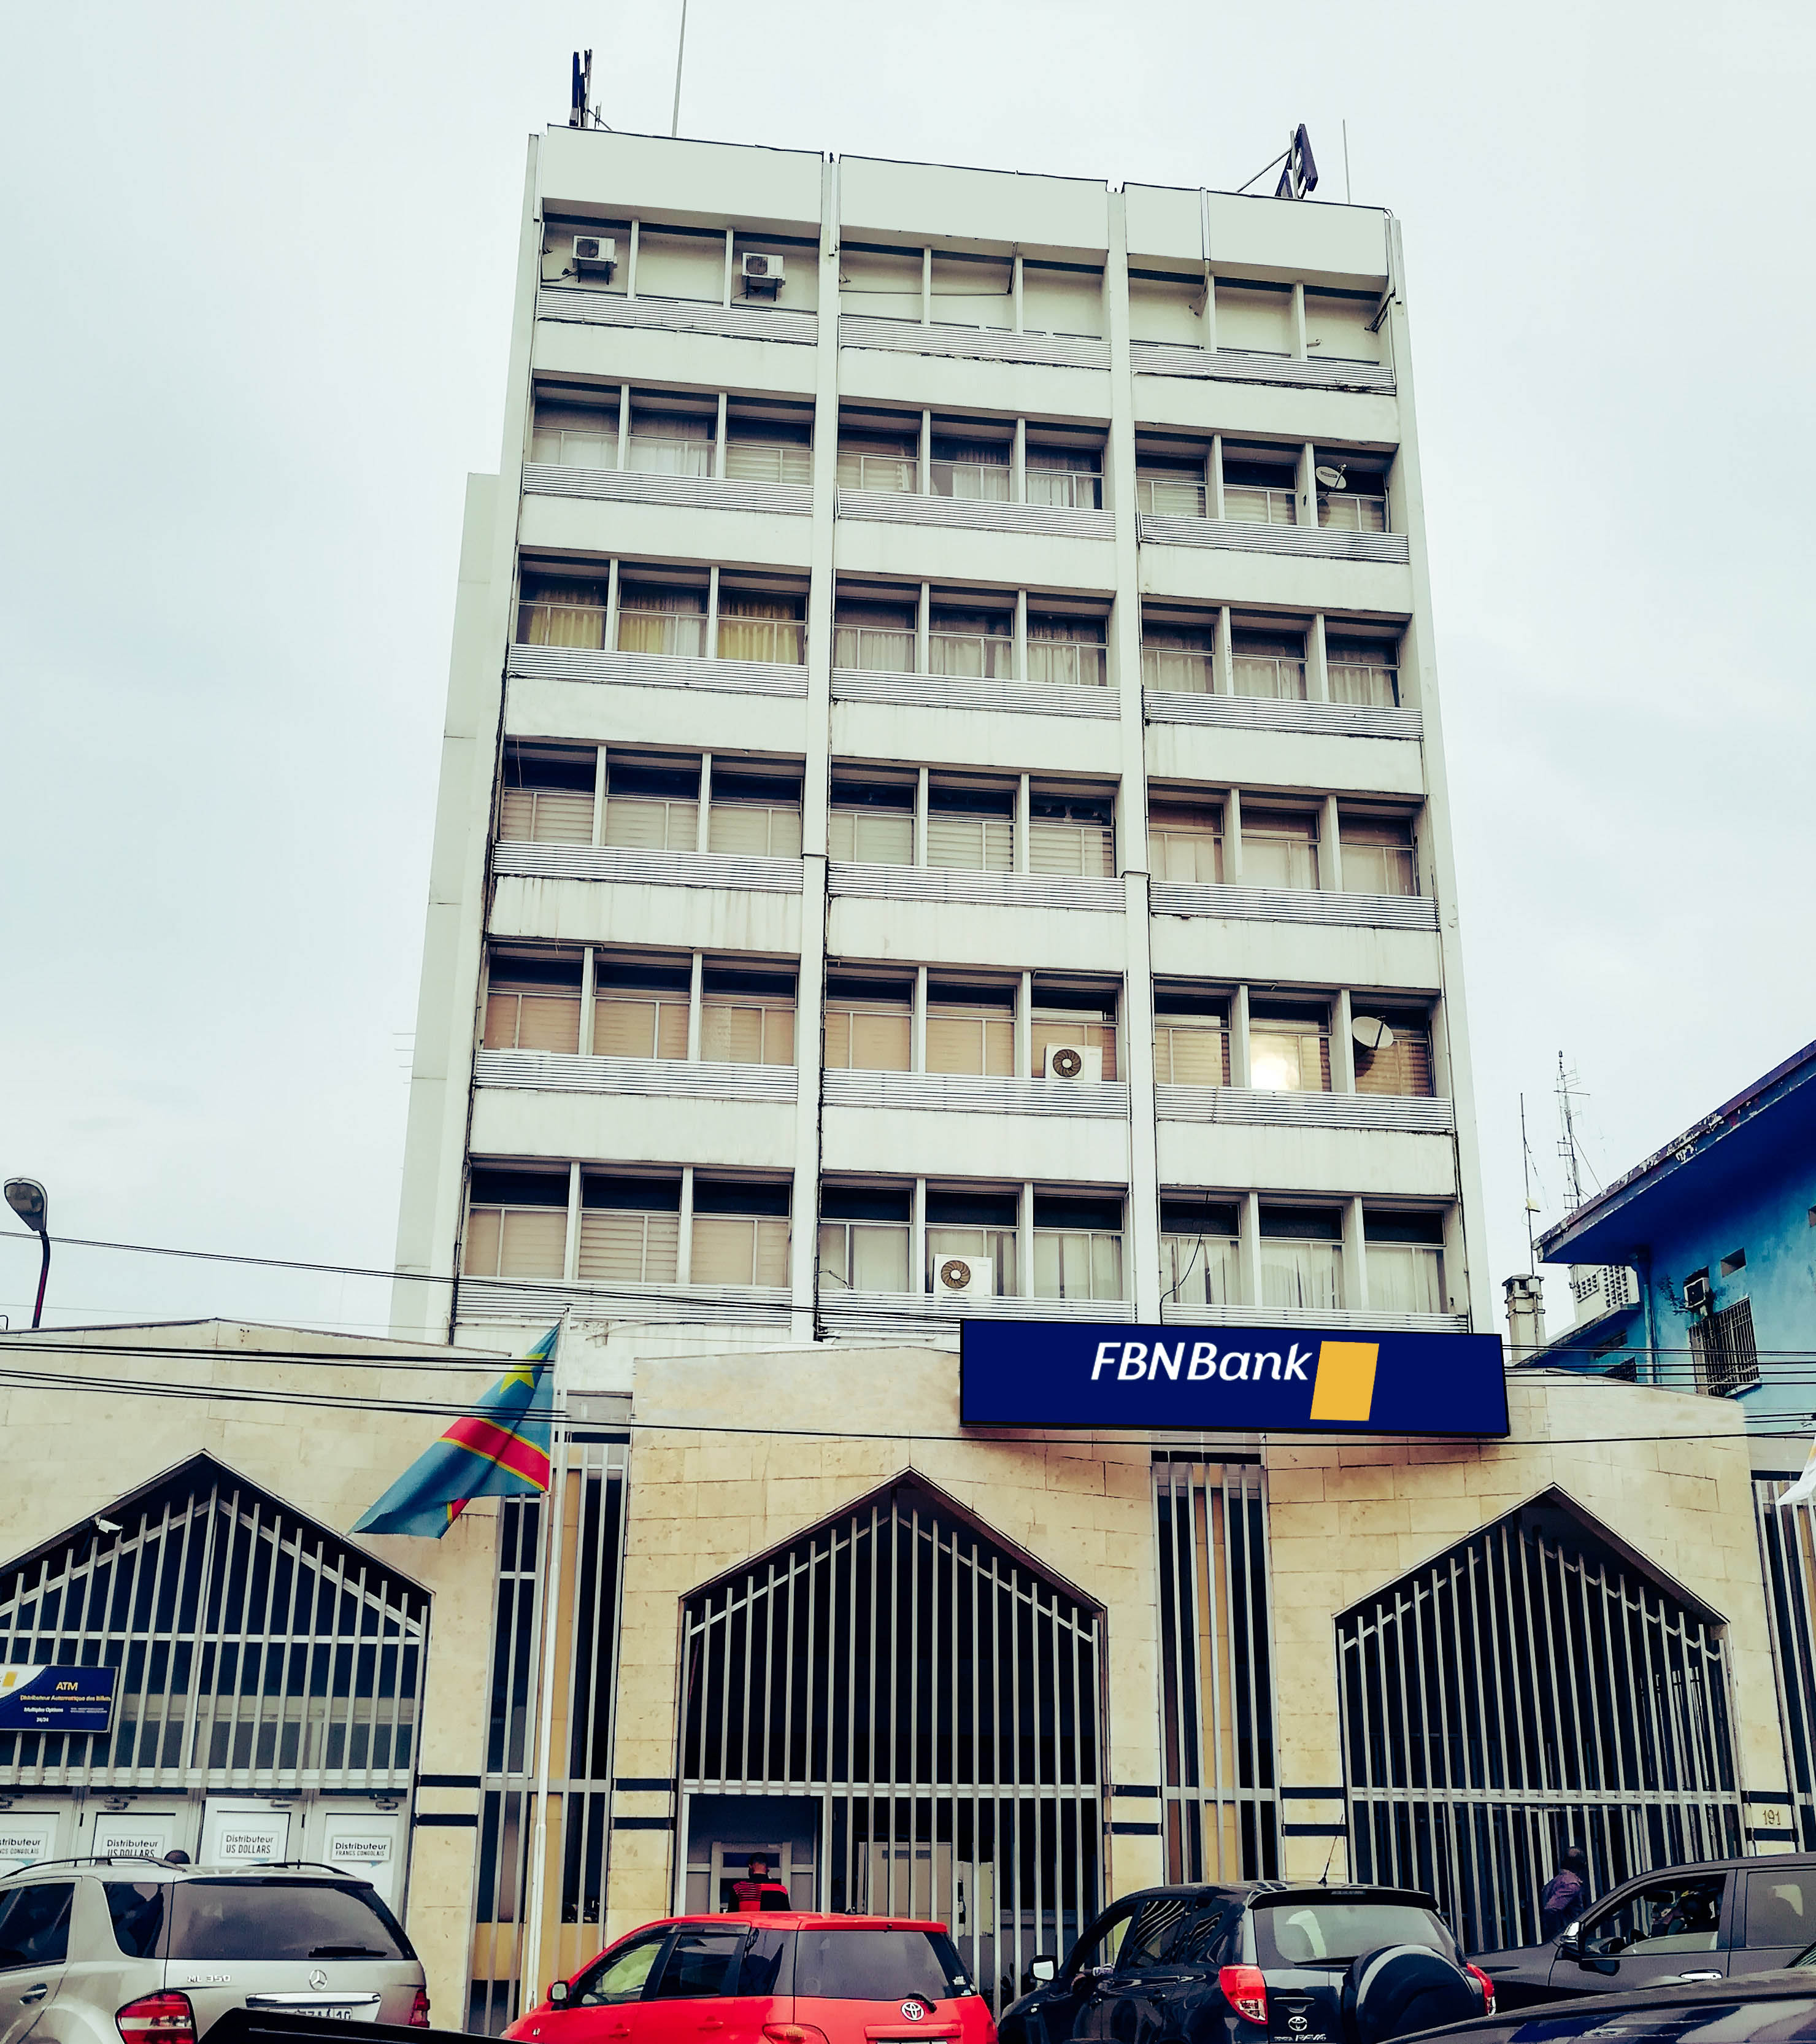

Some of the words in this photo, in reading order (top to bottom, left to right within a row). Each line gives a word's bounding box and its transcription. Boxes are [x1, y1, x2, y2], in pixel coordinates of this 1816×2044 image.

[1090, 1342, 1313, 1381] FBNBank
[56, 1682, 78, 1691] ATM
[1763, 1810, 1780, 1825] 191
[226, 1834, 274, 1843] Distributeur
[120, 1849, 155, 1857] DOLLARS
[226, 1845, 236, 1853] US
[238, 1845, 271, 1854] DOLLARS
